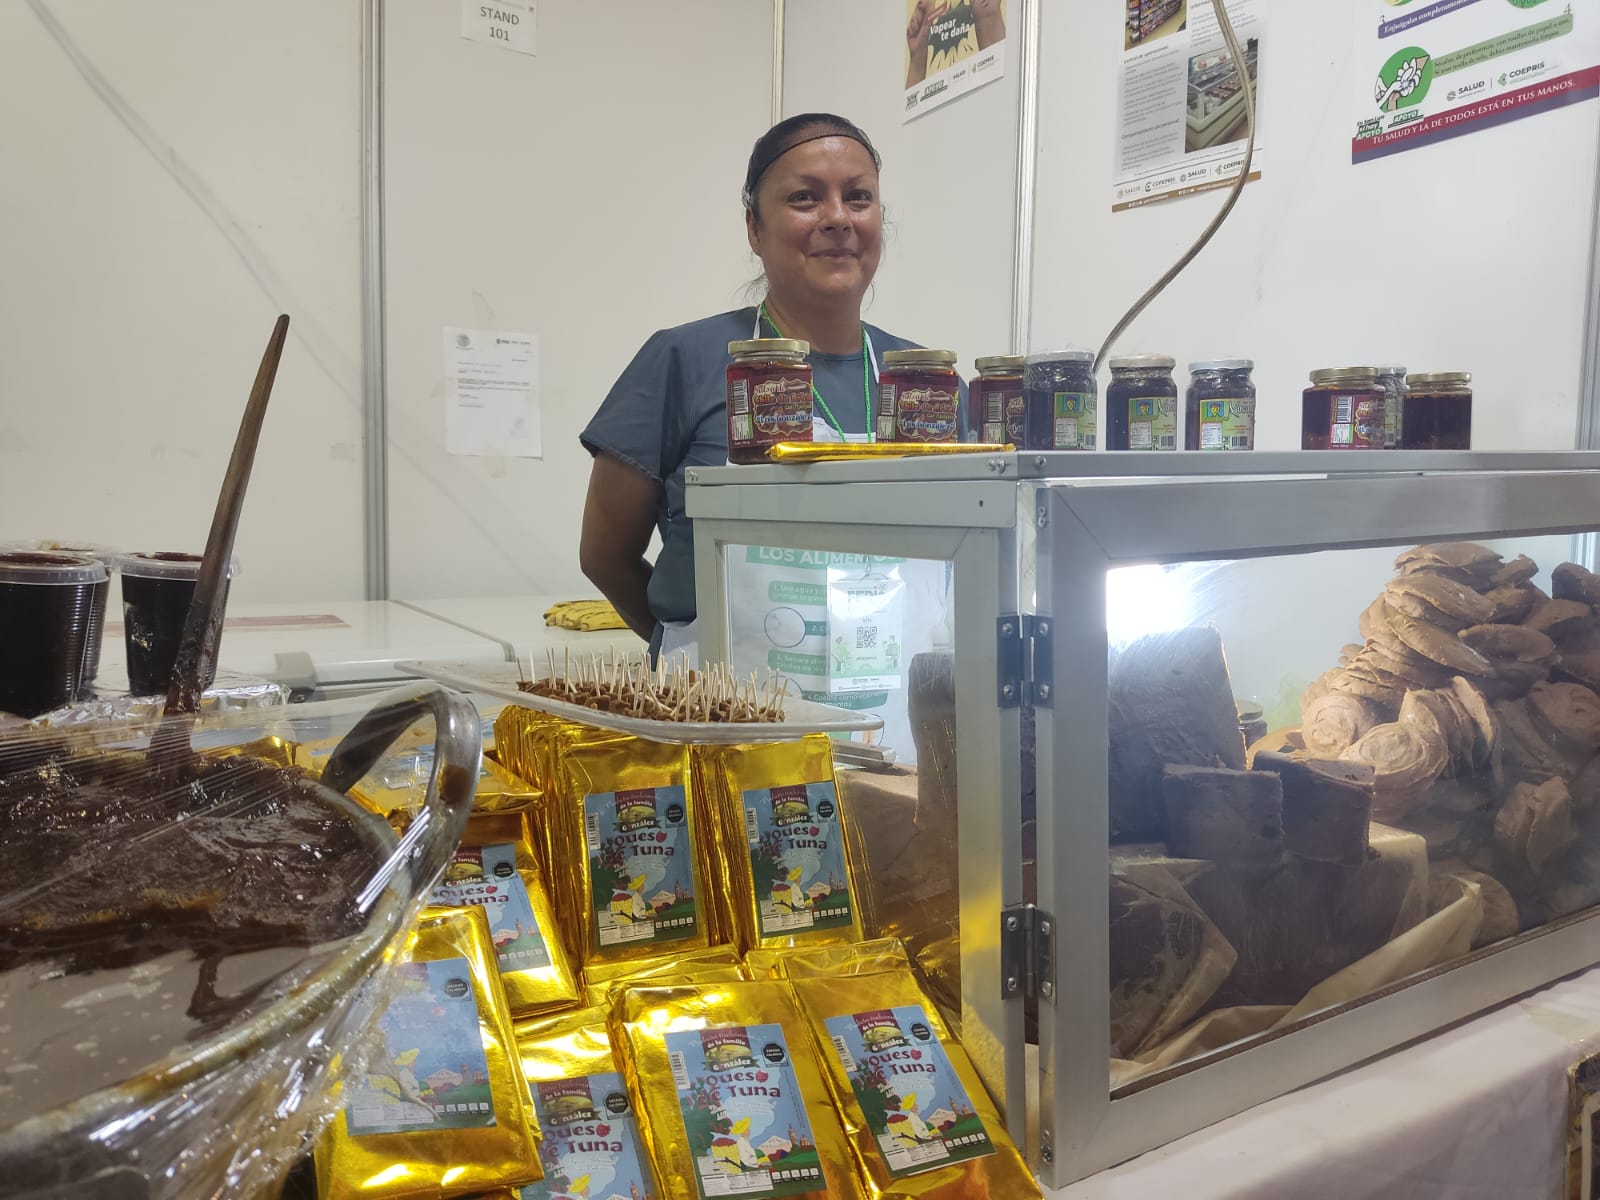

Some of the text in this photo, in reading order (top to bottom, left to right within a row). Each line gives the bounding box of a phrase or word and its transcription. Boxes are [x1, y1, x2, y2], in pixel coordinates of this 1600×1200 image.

[480, 6, 520, 25] STAND
[930, 18, 956, 35] Vapear
[941, 23, 970, 41] te daña
[489, 26, 510, 42] 101
[1509, 62, 1545, 78] COEPRIS
[1458, 81, 1485, 94] SALUD
[1373, 137, 1383, 145] TU
[1386, 129, 1410, 140] SALUD
[1431, 119, 1442, 127] DE
[1445, 109, 1476, 123] TODOS
[1478, 100, 1499, 114] ESTÁ
[1502, 97, 1514, 107] EN
[1517, 91, 1535, 102] TUS
[1537, 79, 1575, 96] MANOS.
[1394, 111, 1417, 122] APOYO
[1223, 160, 1245, 170] COEPRI
[1188, 169, 1206, 178] SALUD
[759, 546, 794, 562] LOS
[622, 820, 655, 832] González
[778, 816, 808, 826] González
[631, 845, 674, 857] Tuna
[789, 839, 828, 850] Tuna
[446, 876, 482, 887] González
[872, 1038, 905, 1052] González
[713, 1058, 751, 1071] González
[889, 1062, 936, 1075] Tuna
[728, 1085, 781, 1097] Tuna
[551, 1111, 592, 1124] González
[567, 1140, 623, 1153] Tuna
